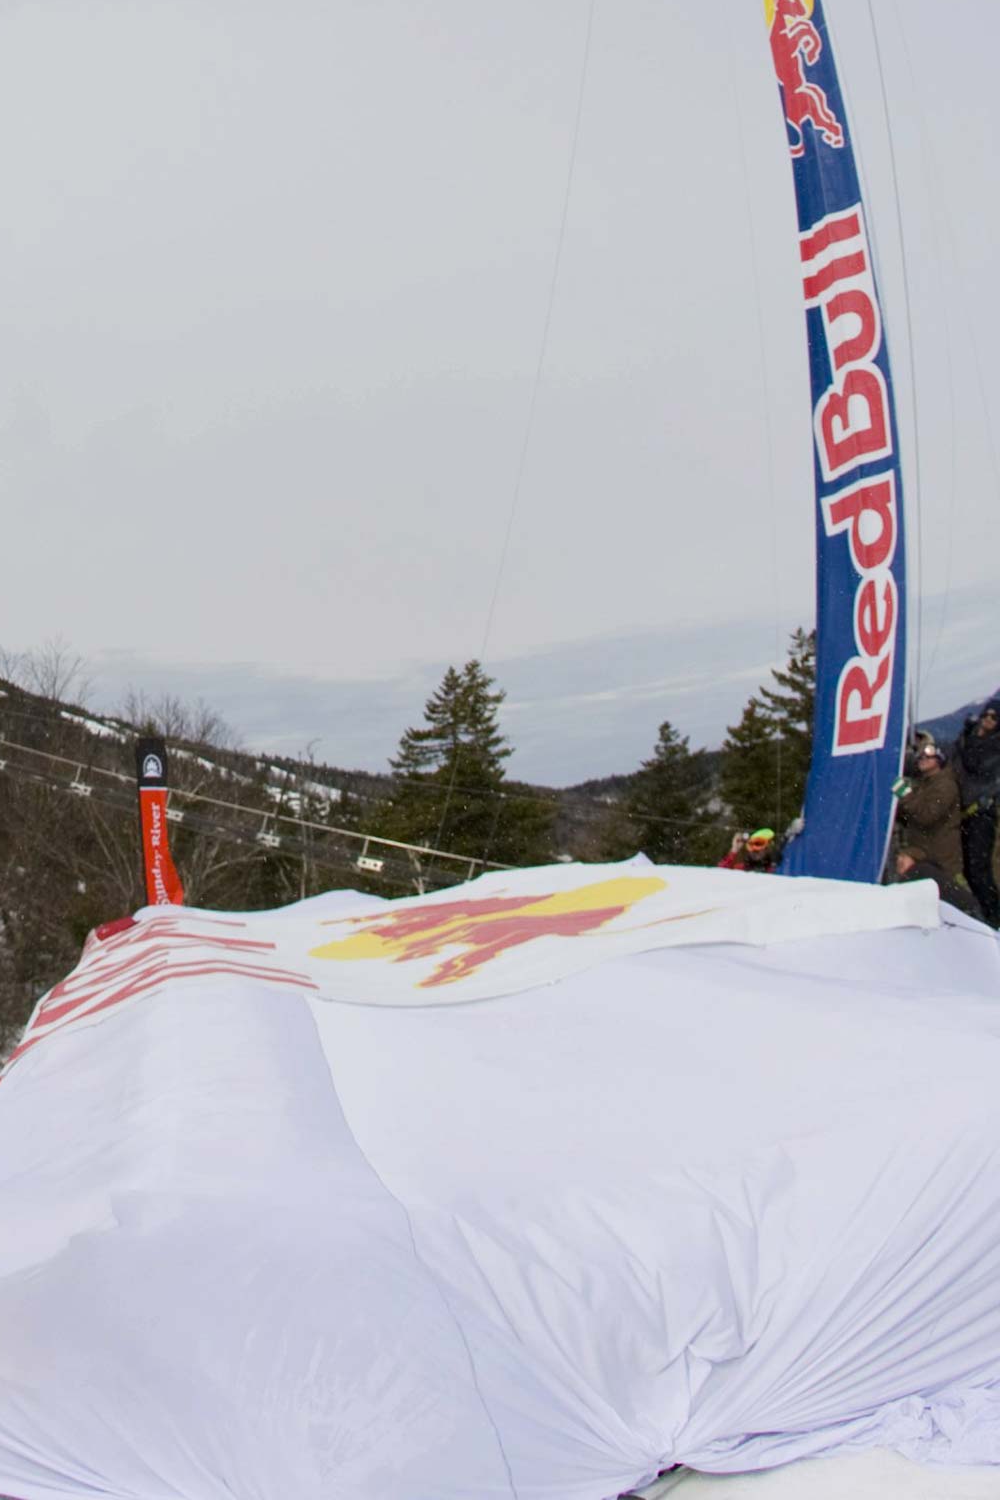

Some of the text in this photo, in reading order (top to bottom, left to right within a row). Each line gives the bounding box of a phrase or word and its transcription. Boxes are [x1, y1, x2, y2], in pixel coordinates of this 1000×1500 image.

[799, 207, 895, 752] Red Bull
[150, 802, 161, 847] River
